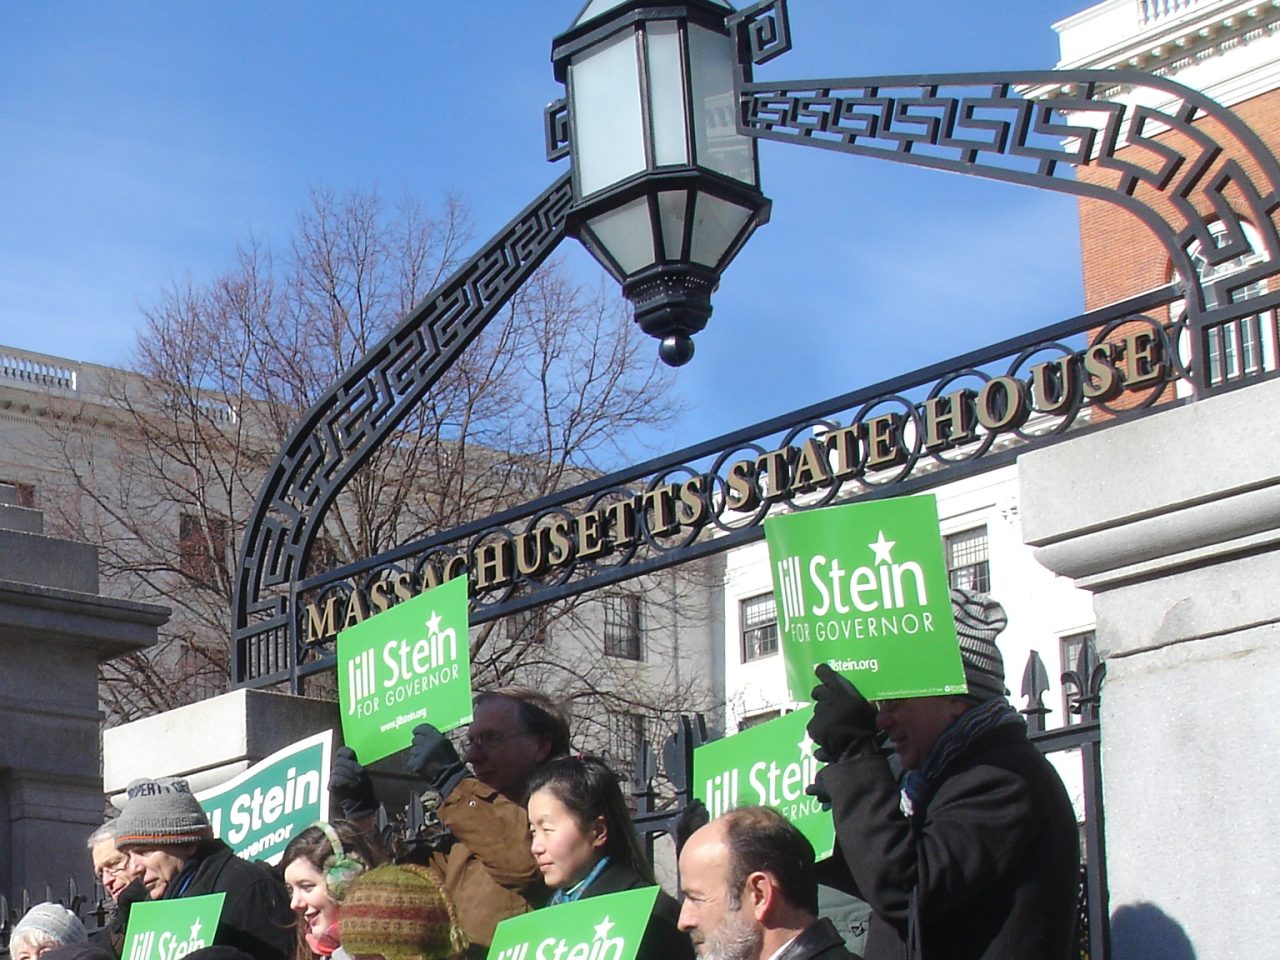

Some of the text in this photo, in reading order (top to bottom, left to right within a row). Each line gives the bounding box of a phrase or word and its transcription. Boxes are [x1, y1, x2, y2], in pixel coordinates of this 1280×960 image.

[306, 327, 1163, 643] MASSACHUSETTS STATE HOUSE
[778, 529, 928, 632] Jill Stein
[348, 610, 457, 715] Jill Stein
[791, 612, 935, 642] FOR GOVERNOR
[357, 663, 459, 719] FOR GOVERNOR
[227, 766, 320, 845] Stein
[235, 823, 294, 860] vernor
